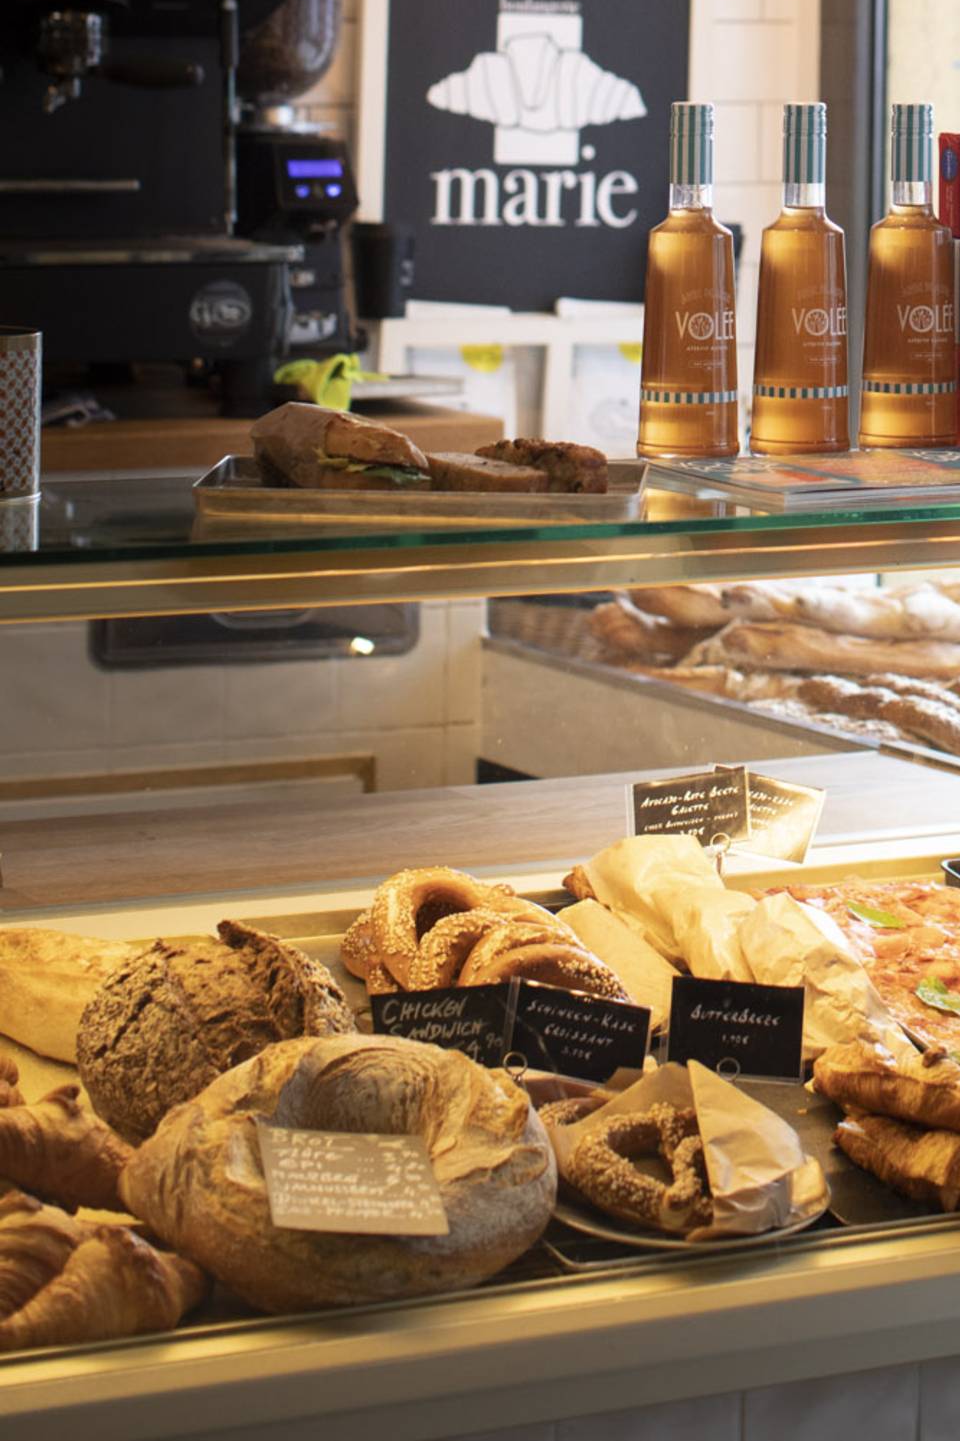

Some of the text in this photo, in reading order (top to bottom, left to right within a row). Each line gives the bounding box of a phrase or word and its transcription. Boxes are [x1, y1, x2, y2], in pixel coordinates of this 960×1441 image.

[430, 144, 638, 227] marie
[381, 995, 469, 1025] CHICKEN
[544, 1022, 614, 1047] CROISSANT
